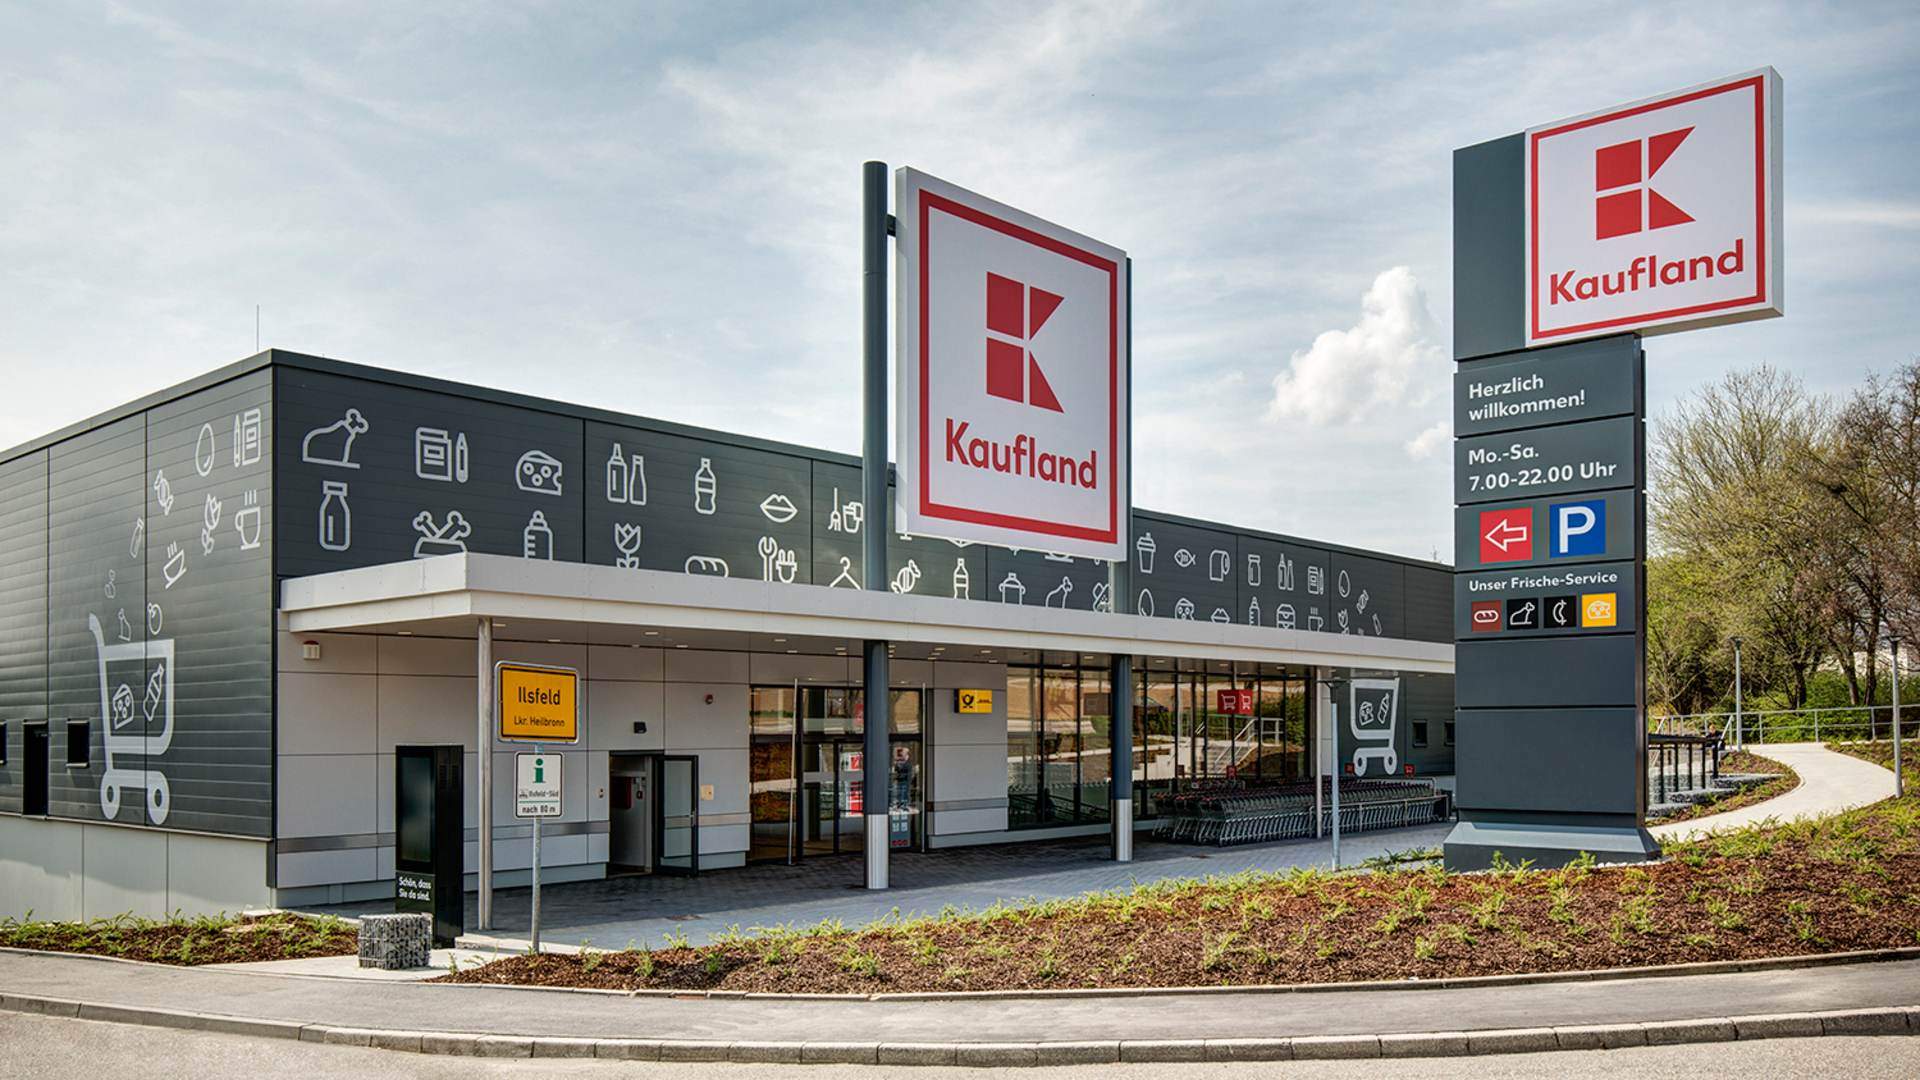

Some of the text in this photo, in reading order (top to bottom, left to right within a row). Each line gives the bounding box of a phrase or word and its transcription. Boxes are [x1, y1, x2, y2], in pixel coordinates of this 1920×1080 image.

[1549, 238, 1744, 305] Kaufland
[1469, 374, 1544, 399] Herzlich
[1468, 389, 1585, 421] willkommen!
[945, 418, 1097, 489] Kaufland
[1468, 444, 1539, 465] Mo.-Sa.
[1469, 462, 1616, 491] 7.00-22.00 Uhr
[1559, 506, 1596, 553] P
[1469, 572, 1618, 591] Unser Frische-Service
[518, 686, 561, 705] Ilsfeld
[514, 716, 565, 728] Lkr. Heilbronn
[522, 805, 538, 813] nach
[399, 876, 432, 889] Schön, dass
[399, 888, 431, 901] Sie da sind.
